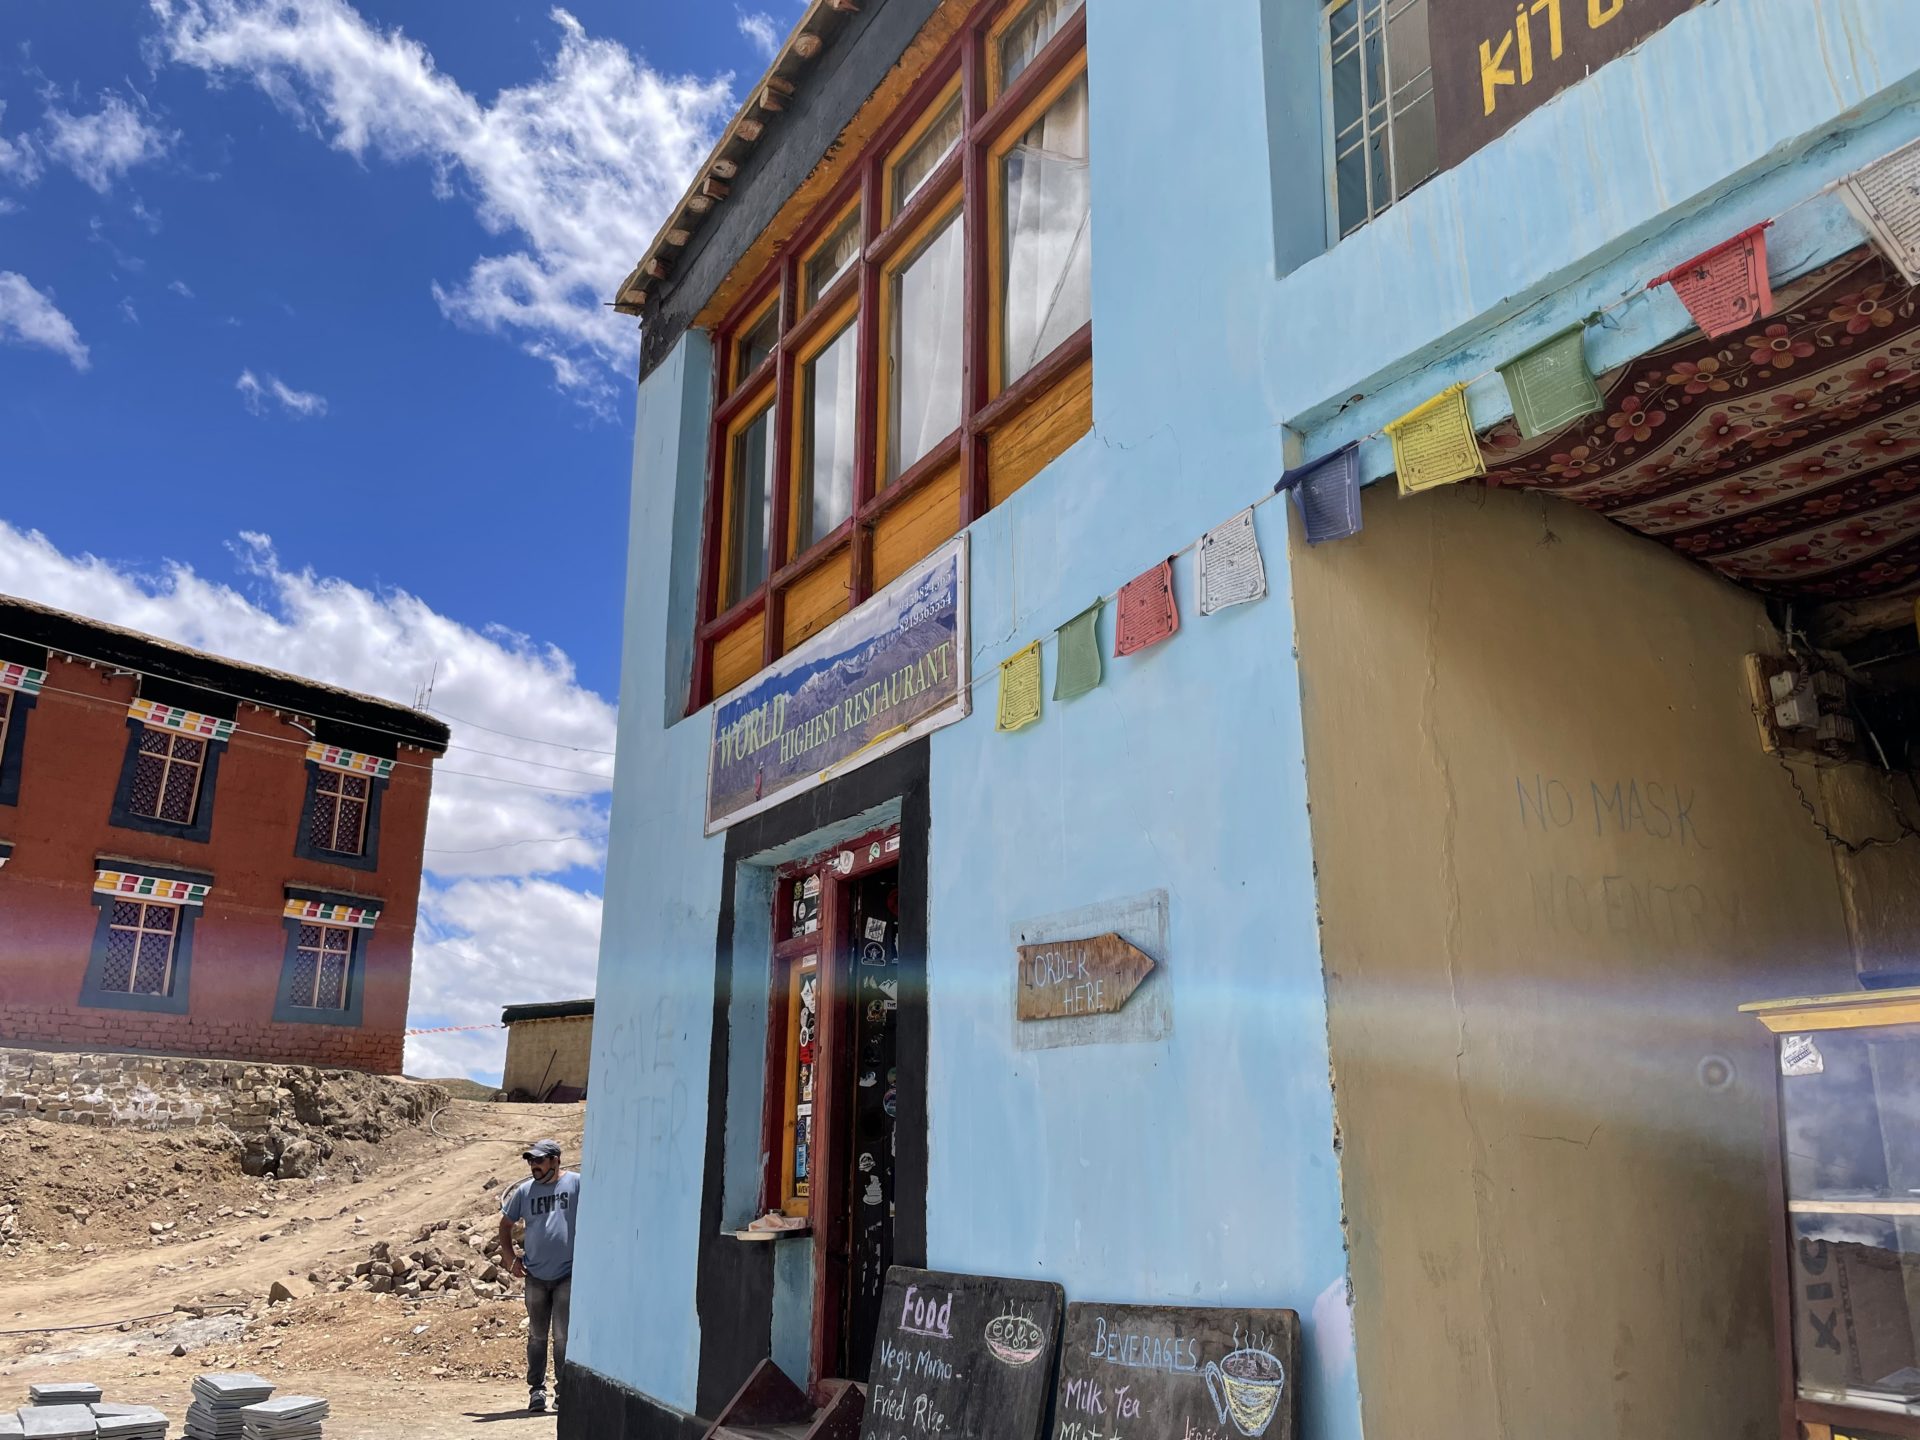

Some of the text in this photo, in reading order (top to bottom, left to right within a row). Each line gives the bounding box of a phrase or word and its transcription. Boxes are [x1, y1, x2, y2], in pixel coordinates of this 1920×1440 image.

[779, 705, 839, 765] HIGHEST
[843, 641, 950, 732] RESTAURANT
[718, 694, 787, 769] WORLD
[1515, 774, 1711, 850] NO MASK
[1526, 871, 1592, 936] NO
[1034, 949, 1090, 987] ORDER
[1063, 979, 1104, 1014] HERE
[530, 1191, 569, 1215] LEVI'S
[900, 1284, 953, 1338] Food
[1090, 1316, 1197, 1372] BEVERAGES
[872, 1384, 907, 1421] Fried
[1065, 1378, 1142, 1419] Milk Tea
